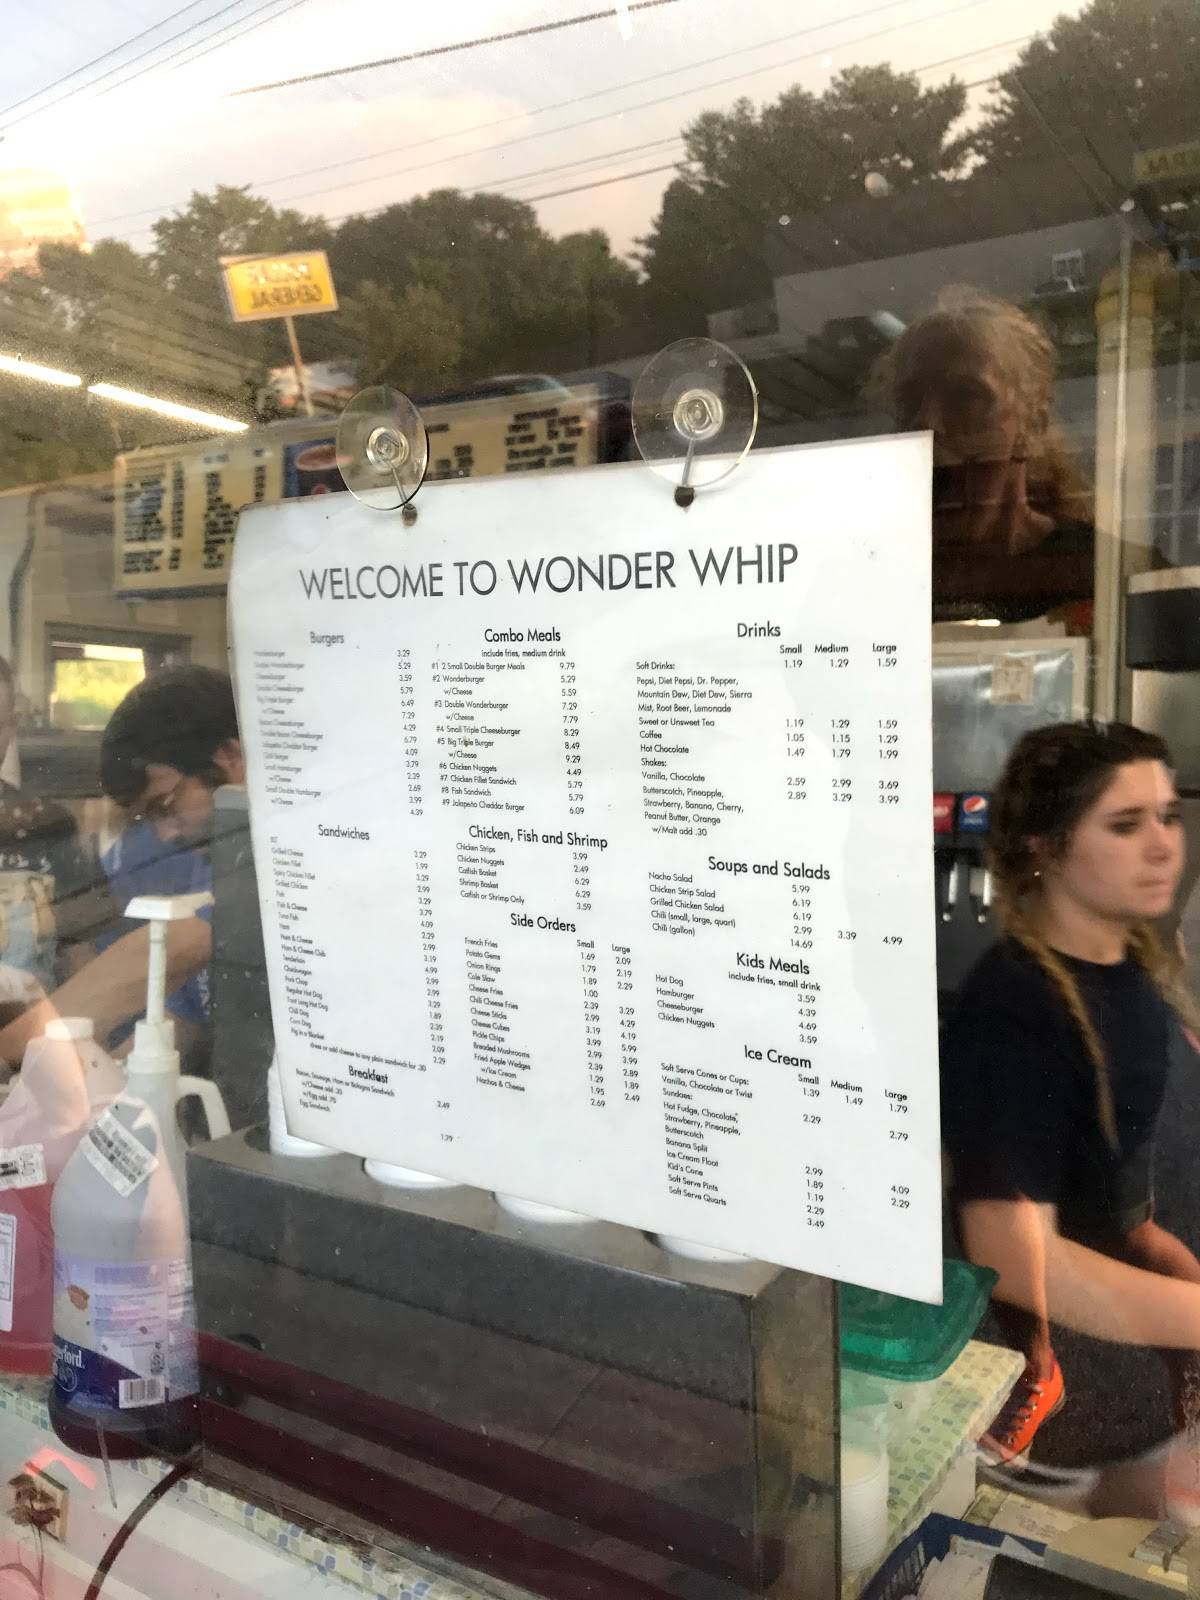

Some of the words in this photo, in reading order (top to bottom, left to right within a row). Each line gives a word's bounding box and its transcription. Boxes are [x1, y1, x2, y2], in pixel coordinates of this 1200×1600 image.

[298, 563, 446, 599] WELCOME
[452, 560, 496, 595] TO
[506, 551, 676, 592] WONDER
[688, 543, 798, 584] WHIP
[484, 628, 523, 642] Combo
[527, 627, 560, 641] Meals
[737, 621, 781, 637] Drinks
[309, 631, 345, 647] Burgers
[779, 643, 802, 654] Small
[814, 643, 848, 653] Medium
[872, 643, 896, 654] Large
[559, 662, 575, 670] 9.79
[636, 660, 649, 669] Soft
[650, 661, 674, 670] Drinks:
[784, 659, 802, 668] 1.19
[830, 658, 848, 668] 1.29
[878, 657, 897, 667] 1.59
[432, 674, 440, 682] #2
[442, 674, 485, 684] Wonderburger
[560, 674, 575, 683] 5.29
[636, 676, 656, 686] Pepsi,
[658, 676, 672, 685] Diet
[674, 676, 694, 686] Pepsi,
[696, 676, 707, 685] Dr.
[710, 676, 738, 686] Pepper,
[561, 688, 576, 696] 5.59
[637, 690, 670, 698] Mountain
[671, 689, 689, 699] Dew,
[692, 689, 706, 698] Diet
[708, 689, 727, 700] Dew,
[729, 689, 752, 698] Sierra
[562, 701, 577, 710] 7.29
[637, 703, 654, 712] Mist,
[656, 703, 672, 712] Root
[673, 703, 691, 712] Beer,
[693, 703, 731, 712] Lemonade
[562, 715, 578, 723] 7.79
[638, 716, 659, 725] Sweet
[670, 717, 700, 726] Unsweet
[701, 717, 715, 726] Tea
[786, 718, 804, 727] 1.19
[831, 719, 849, 728] 1.29
[878, 719, 897, 729] 1.59
[563, 728, 579, 736] 8.29
[639, 729, 662, 739] Coffee
[786, 732, 804, 742] 1.05
[832, 733, 850, 743] 1.15
[879, 734, 898, 743] 1.29
[564, 741, 580, 750] 8.49
[640, 743, 652, 752] Hot
[653, 743, 689, 753] Chocolate
[787, 747, 805, 756] 1.49
[832, 748, 850, 757] 1.79
[879, 749, 898, 759] 1.99
[565, 754, 580, 763] 9.29
[566, 768, 581, 776] 4.49
[567, 780, 582, 788] 5.79
[641, 771, 667, 781] Vanilla,
[669, 772, 705, 781] Chocolate
[786, 776, 805, 786] 2.59
[831, 778, 851, 787] 2.99
[878, 780, 898, 789] 3.69
[568, 793, 583, 801] 5.79
[787, 790, 806, 799] 2.89
[832, 792, 852, 801] 3.29
[879, 794, 899, 804] 3.99
[569, 806, 584, 814] 6.09
[318, 824, 369, 840] Sandwiches
[468, 824, 513, 842] Chicken,
[517, 828, 538, 842] Fish
[541, 830, 563, 844] and
[566, 832, 607, 851] Shrimp
[572, 851, 587, 860] 3.99
[573, 864, 589, 873] 2.49
[708, 856, 748, 875] Soups
[752, 860, 778, 875] and
[783, 861, 830, 880] Salads
[574, 877, 589, 885] 6.29
[648, 871, 671, 881] Nacho
[672, 873, 693, 883] Salad
[791, 884, 810, 893] 5.99
[575, 890, 590, 898] 6.29
[649, 884, 676, 894] Chicken
[677, 886, 694, 897] Strip
[695, 888, 715, 898] Salad
[792, 898, 811, 907] 6.19
[576, 902, 591, 910] 3.59
[649, 897, 673, 907] Grilled
[674, 899, 702, 910] Chicken
[703, 902, 724, 912] Salad
[792, 911, 811, 921] 6.19
[510, 912, 533, 927] Side
[536, 916, 576, 932] Orders
[793, 925, 812, 935] 2.99
[837, 930, 856, 940] 3.39
[882, 936, 902, 945] 4.99
[576, 939, 594, 948] Small
[611, 943, 630, 954] Large
[790, 938, 813, 949] 14.69
[580, 951, 595, 960] 1.69
[615, 956, 631, 965] 2.09
[736, 952, 764, 969] Kids
[769, 957, 809, 974] Meals
[581, 964, 596, 973] 1.79
[616, 968, 632, 977] 2.19
[582, 976, 597, 985] 1.89
[617, 981, 632, 990] 2.29
[728, 971, 755, 982] include
[756, 974, 775, 986] fries,
[778, 979, 798, 988] small
[800, 980, 820, 991] drink
[655, 974, 667, 983] Hot
[668, 975, 683, 987] Dog
[797, 993, 815, 1003] 3.59
[656, 987, 694, 1000] Hamburger
[798, 1008, 816, 1017] 4.39
[619, 1006, 634, 1015] 3.29
[657, 999, 703, 1014] Cheeseburger
[798, 1021, 816, 1030] 4.69
[619, 1019, 635, 1028] 4.29
[620, 1031, 636, 1040] 4.19
[799, 1033, 817, 1044] 3.59
[621, 1043, 637, 1053] 5.99
[622, 1055, 637, 1065] 3.99
[744, 1044, 762, 1060] Ice
[766, 1049, 811, 1068] Cream
[348, 1065, 388, 1083] Breakfast
[798, 1073, 819, 1084] Small
[830, 1080, 862, 1092] Medium
[884, 1089, 907, 1102] Large
[803, 1087, 820, 1097] 1.39
[845, 1095, 863, 1105] 1.49
[889, 1103, 907, 1113] 1.79
[802, 1113, 821, 1124] 2.29
[889, 1130, 908, 1141] 2.79
[666, 1149, 676, 1158] Ice
[677, 1151, 700, 1163] Cream
[701, 1156, 718, 1167] Float
[807, 1178, 823, 1189] 1.89
[891, 1197, 909, 1208] 2.29
[805, 1165, 823, 1176] 2.99
[890, 1185, 909, 1195] 4.09
[807, 1191, 823, 1202] 1.19
[806, 1204, 824, 1215] 2.29
[807, 1217, 824, 1228] 3.49
